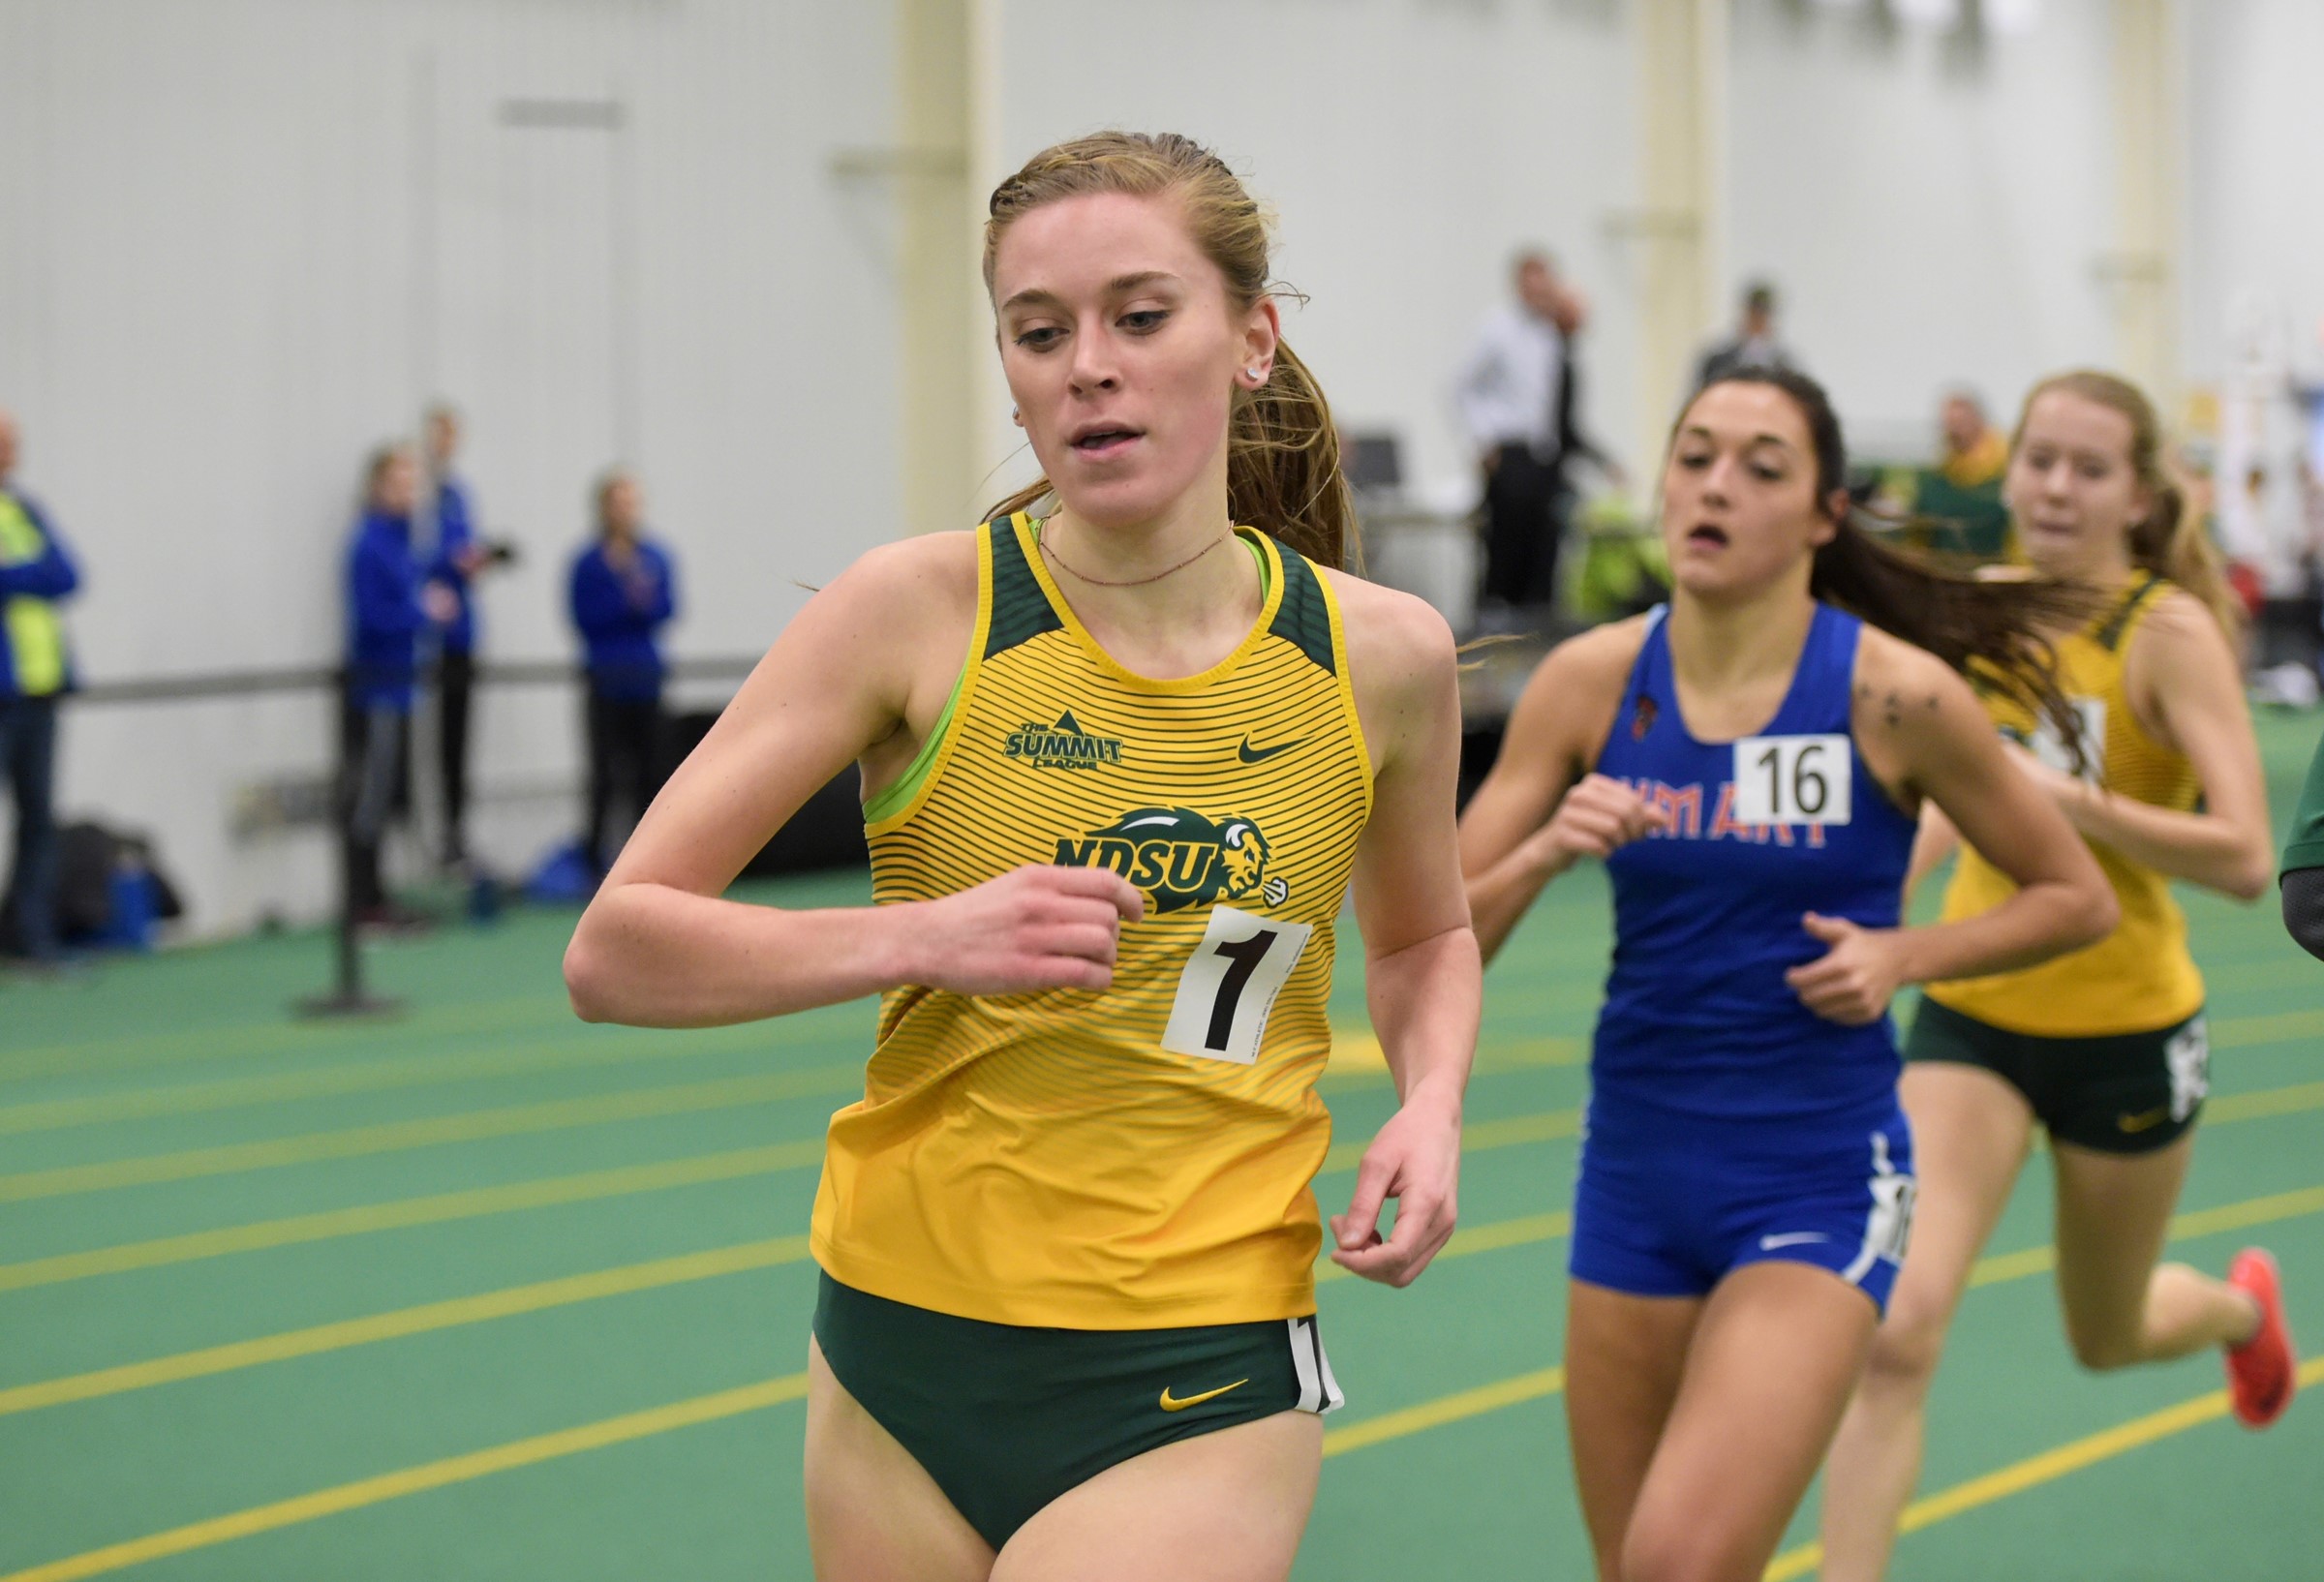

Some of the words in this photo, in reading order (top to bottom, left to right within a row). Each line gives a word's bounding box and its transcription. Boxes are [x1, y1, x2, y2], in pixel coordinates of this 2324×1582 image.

[1005, 732, 1123, 763] SUMMIT
[1020, 722, 1049, 733] THE
[1031, 756, 1098, 770] LEAGUE
[1758, 745, 1826, 815] 16
[1053, 837, 1216, 888] NDSU
[1204, 928, 1279, 1051] 1
